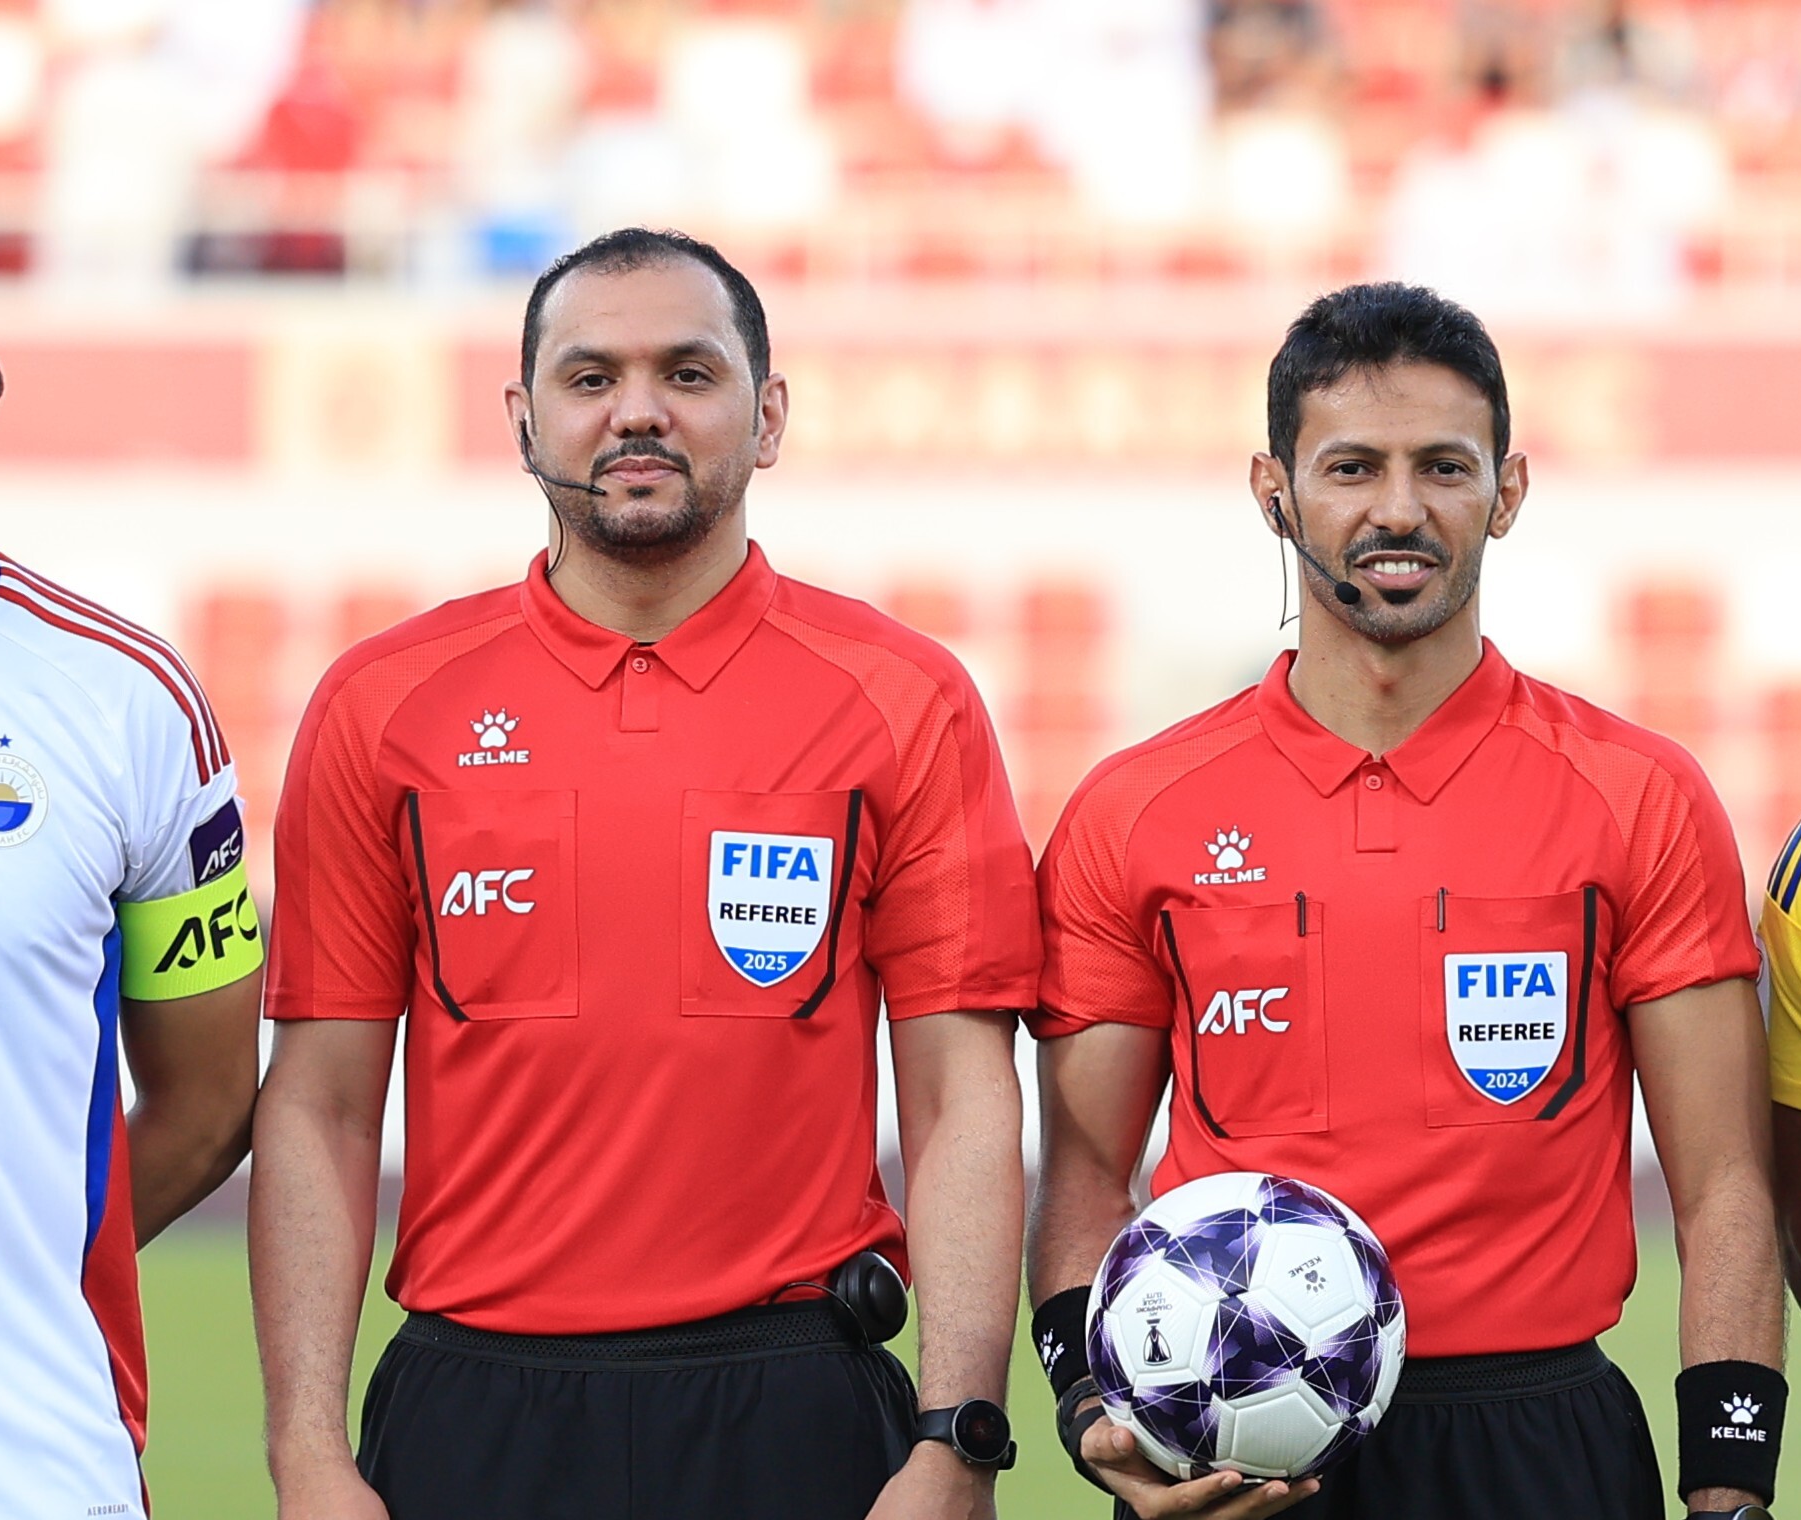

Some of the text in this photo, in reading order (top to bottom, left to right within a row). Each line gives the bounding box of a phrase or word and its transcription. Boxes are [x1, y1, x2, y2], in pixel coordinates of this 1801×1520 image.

[458, 749, 530, 767] KELME
[17, 828, 29, 840] FC
[722, 842, 820, 881] FIFA
[1194, 867, 1266, 885] KELME
[440, 868, 535, 916] AFC
[719, 902, 817, 925] REFEREE
[152, 884, 258, 974] AFC
[743, 953, 788, 972] 2025
[1457, 963, 1556, 998] FIFA
[1197, 987, 1291, 1035] AFC
[1458, 1022, 1555, 1042] REFEREE
[1485, 1071, 1529, 1089] 2024
[1288, 1256, 1323, 1278] KELME
[1711, 1426, 1767, 1442] KELME
[87, 1504, 129, 1517] AEROREADY
